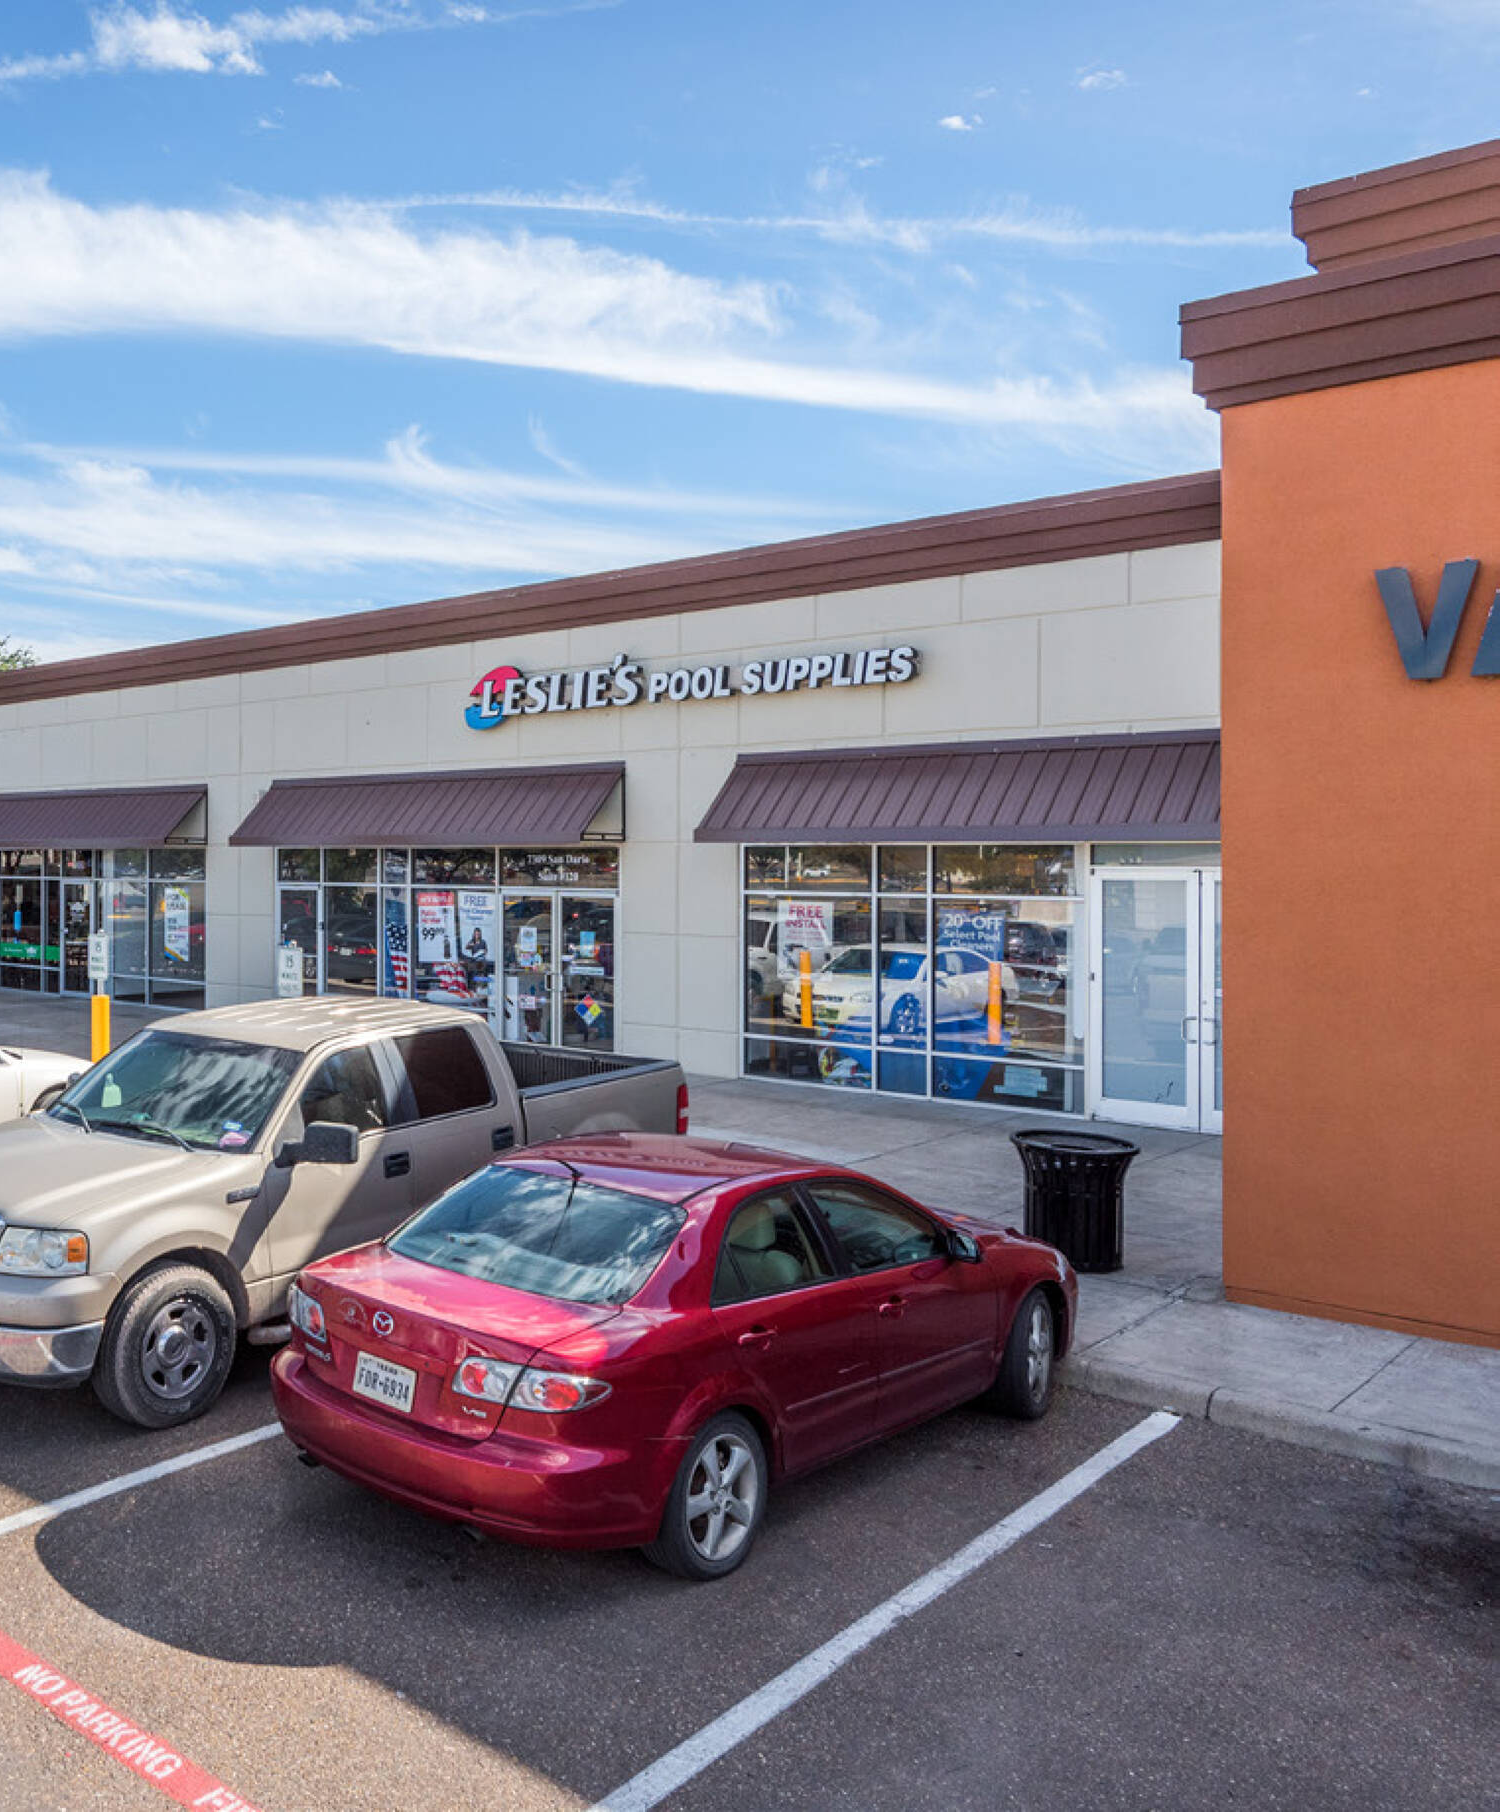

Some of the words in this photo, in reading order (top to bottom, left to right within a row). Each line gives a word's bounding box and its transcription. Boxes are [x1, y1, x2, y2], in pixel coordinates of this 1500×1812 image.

[480, 654, 642, 719] LESLIE'S
[649, 666, 731, 702] POOL
[741, 646, 917, 695] SUPPLIES
[565, 854, 591, 864] Dario
[463, 895, 488, 906] FREE
[789, 904, 824, 918] FREE
[972, 915, 1004, 930] OFF
[944, 928, 975, 940] Select
[977, 931, 1001, 942] Pool
[13, 1663, 66, 1695] NO
[50, 1689, 183, 1780] PARKING
